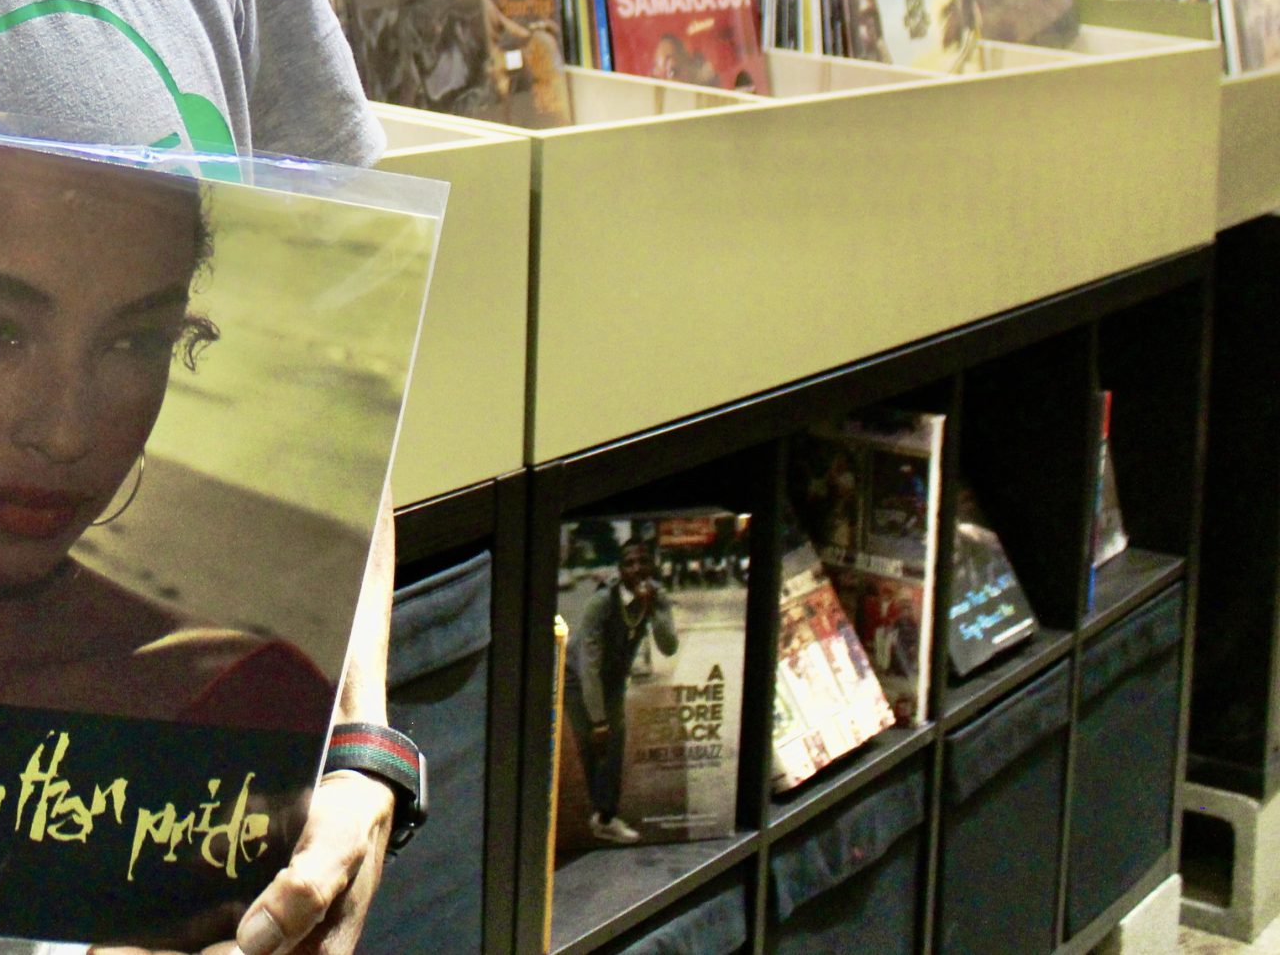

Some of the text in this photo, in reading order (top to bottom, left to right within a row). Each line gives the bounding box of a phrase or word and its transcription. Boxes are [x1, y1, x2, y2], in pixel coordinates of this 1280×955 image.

[707, 664, 724, 682] A
[673, 683, 724, 703] TIME
[127, 771, 270, 881] pride
